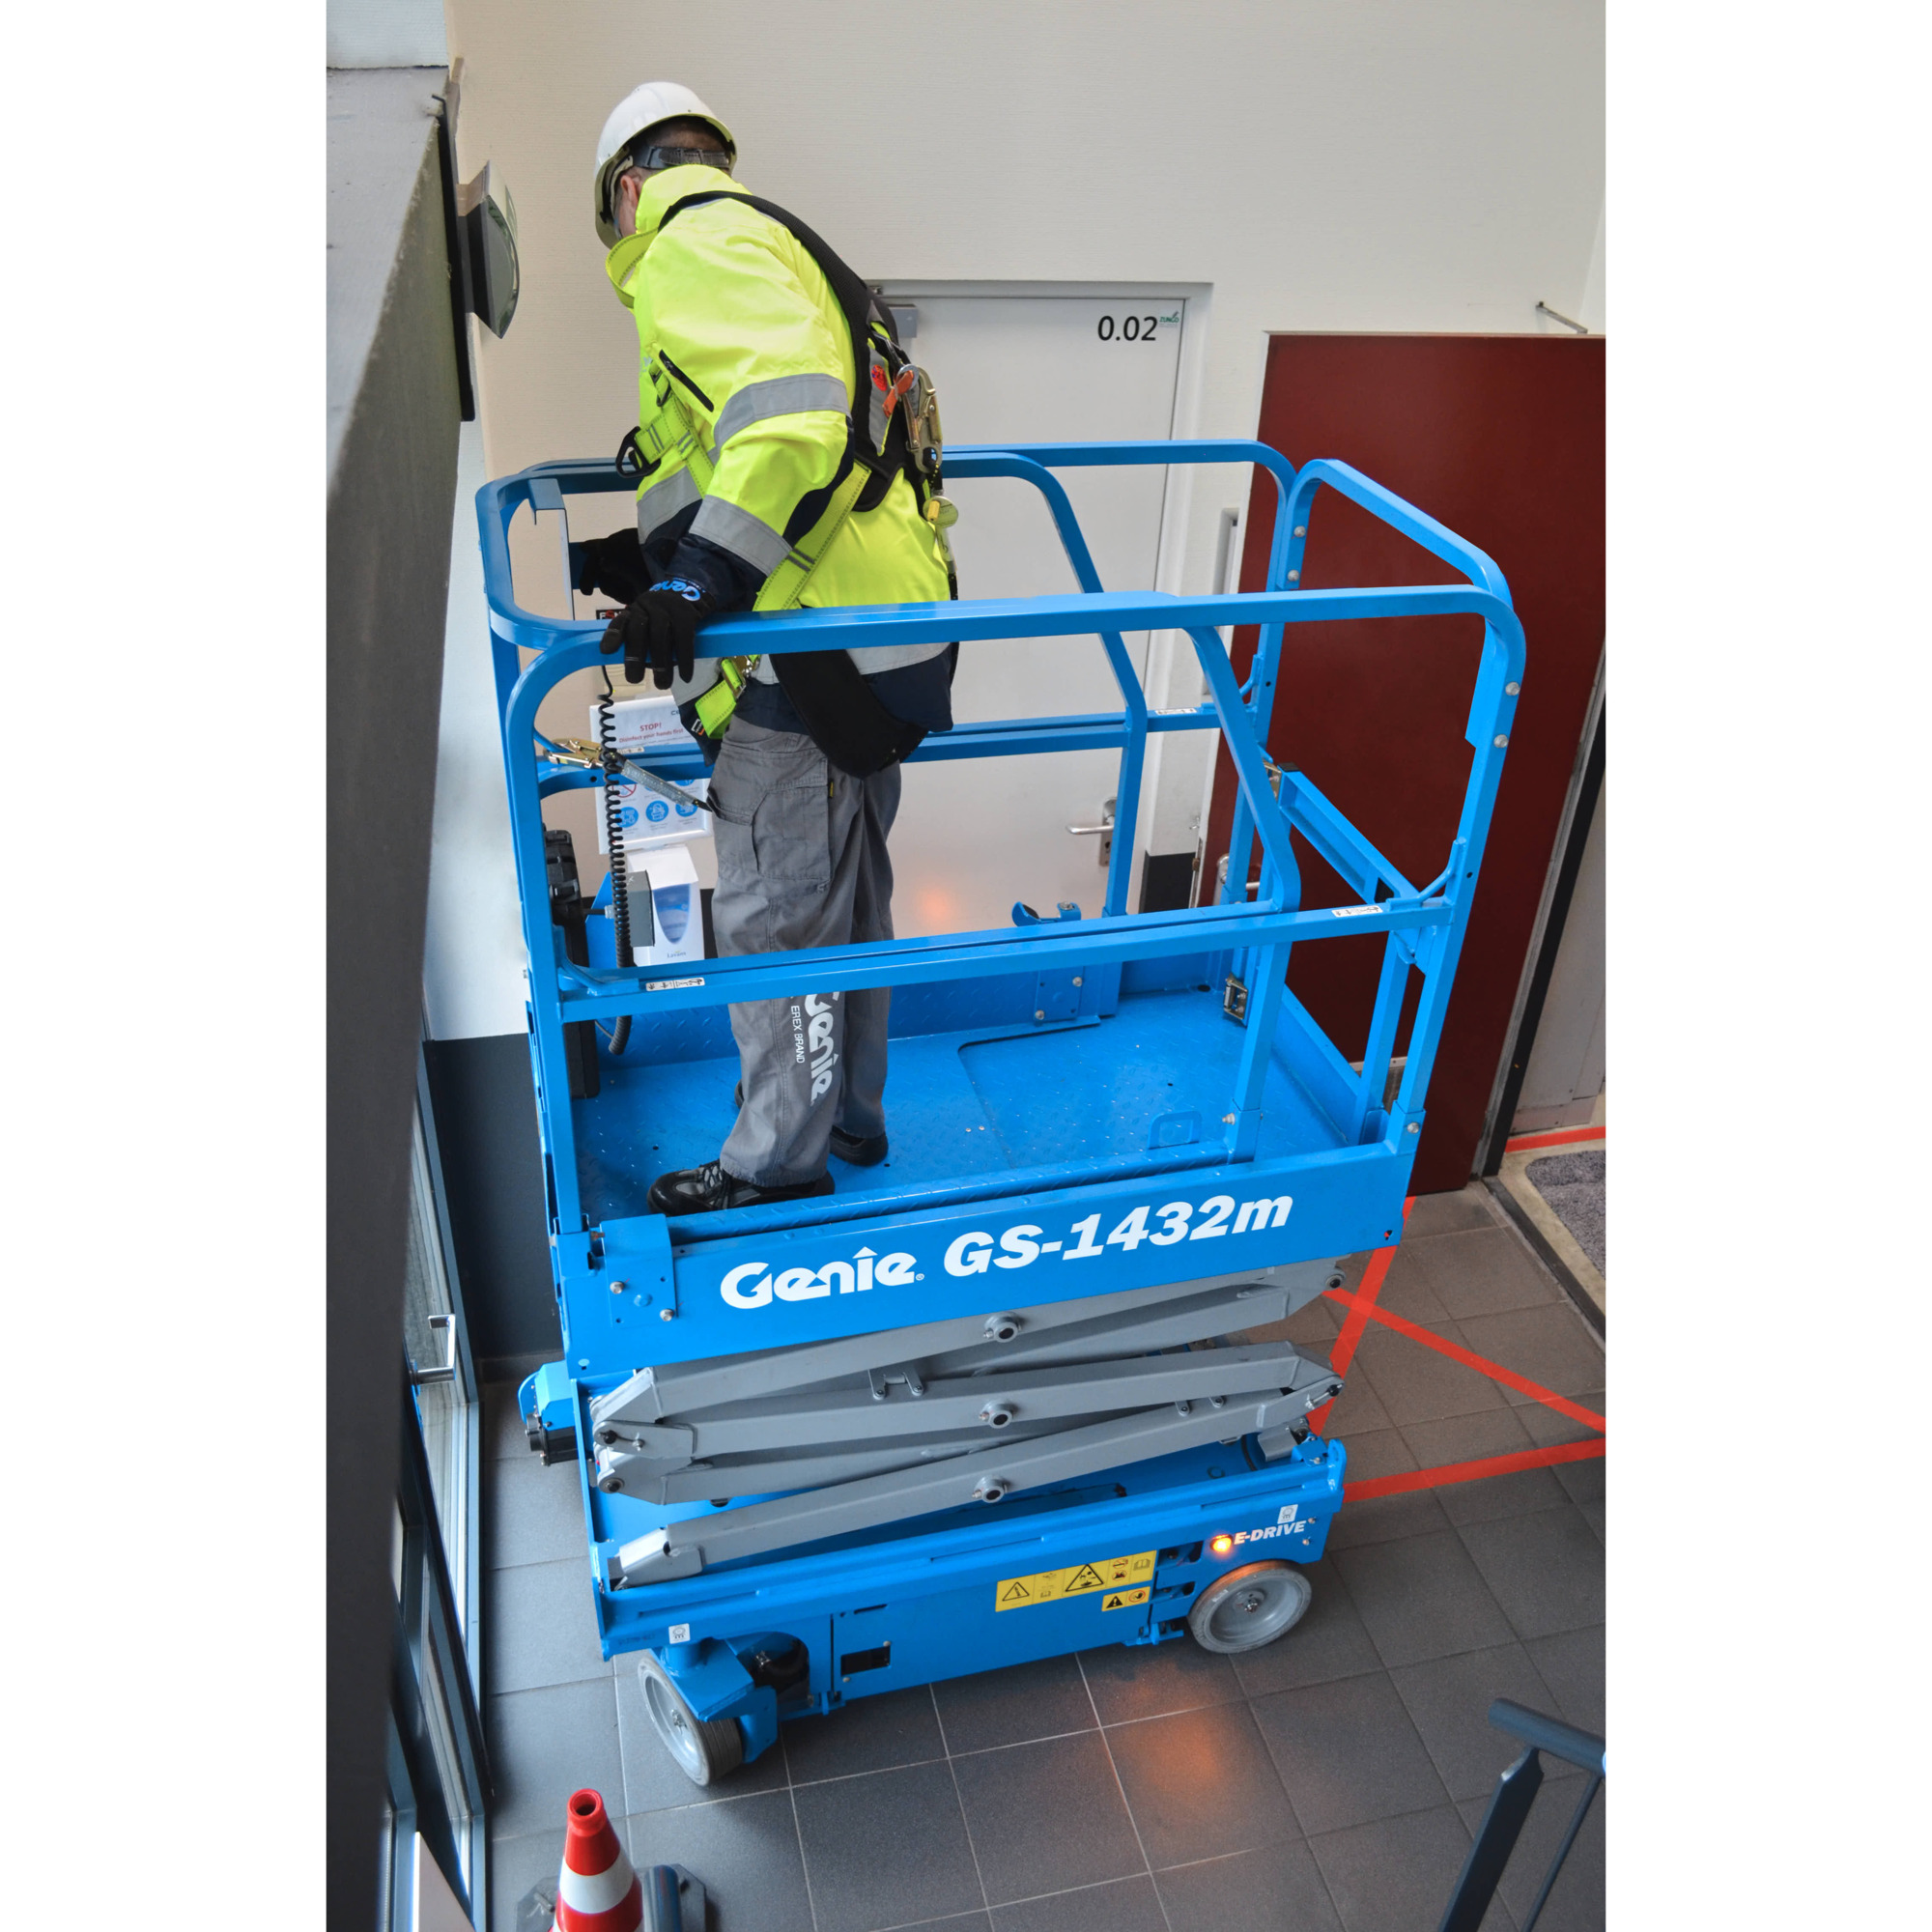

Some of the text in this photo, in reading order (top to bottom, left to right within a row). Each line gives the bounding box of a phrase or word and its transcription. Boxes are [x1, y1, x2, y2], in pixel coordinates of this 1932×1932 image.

[1097, 315, 1158, 341] 0.02
[639, 722, 662, 731] STOP!
[790, 996, 806, 1064] EREX BRAND
[943, 1194, 1294, 1277] GS-1432m
[1234, 1520, 1307, 1546] E-DRIVE
